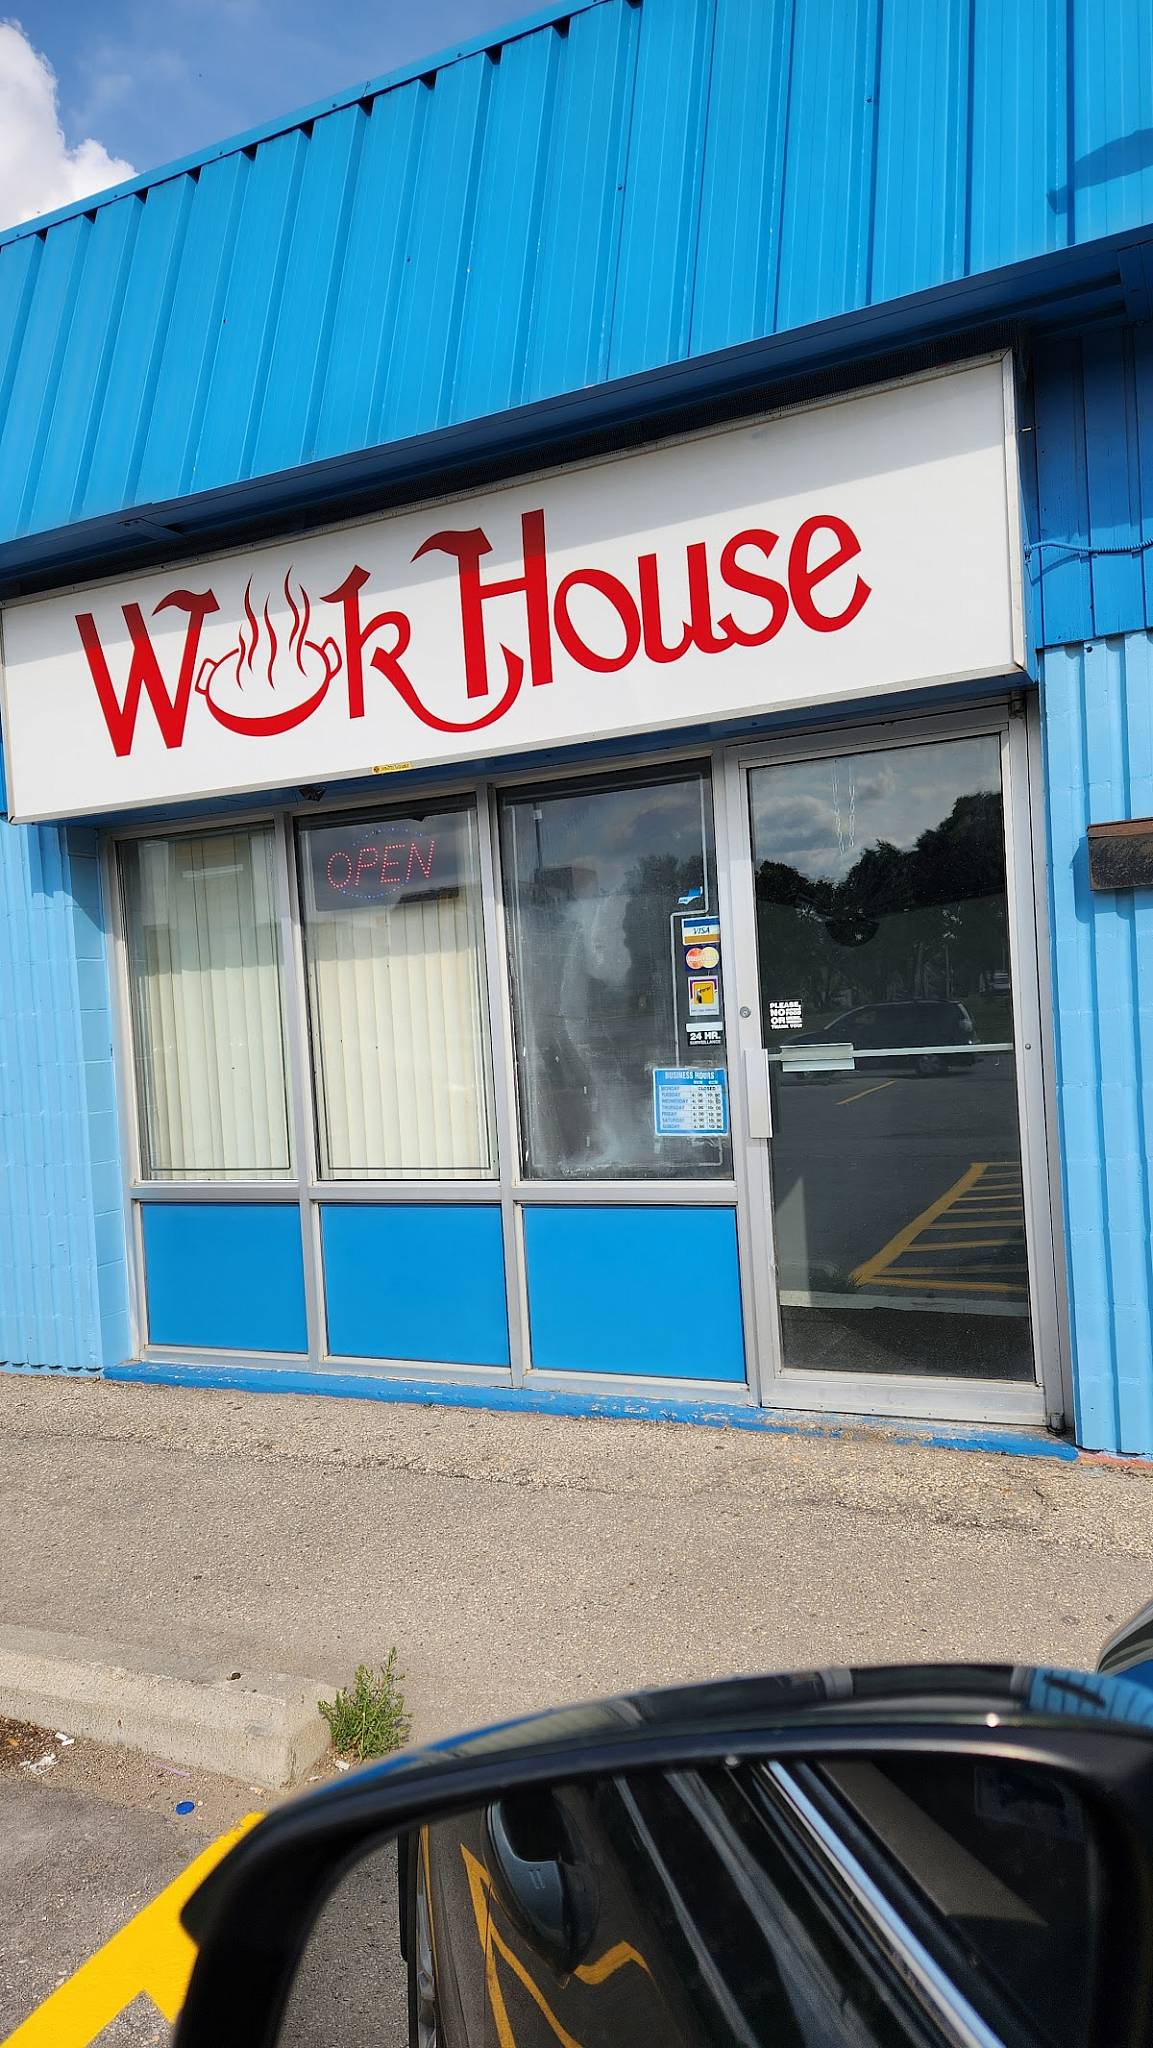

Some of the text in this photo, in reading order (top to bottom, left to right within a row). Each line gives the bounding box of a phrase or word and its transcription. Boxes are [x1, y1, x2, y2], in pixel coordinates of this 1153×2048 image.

[411, 509, 872, 699] House
[327, 840, 436, 889] OPEN
[693, 926, 710, 935] VISA
[770, 1008, 786, 1017] NO
[770, 1016, 786, 1025] OR
[689, 1031, 721, 1041] 24 HR.
[664, 1071, 715, 1080] BUSINESS HOURS
